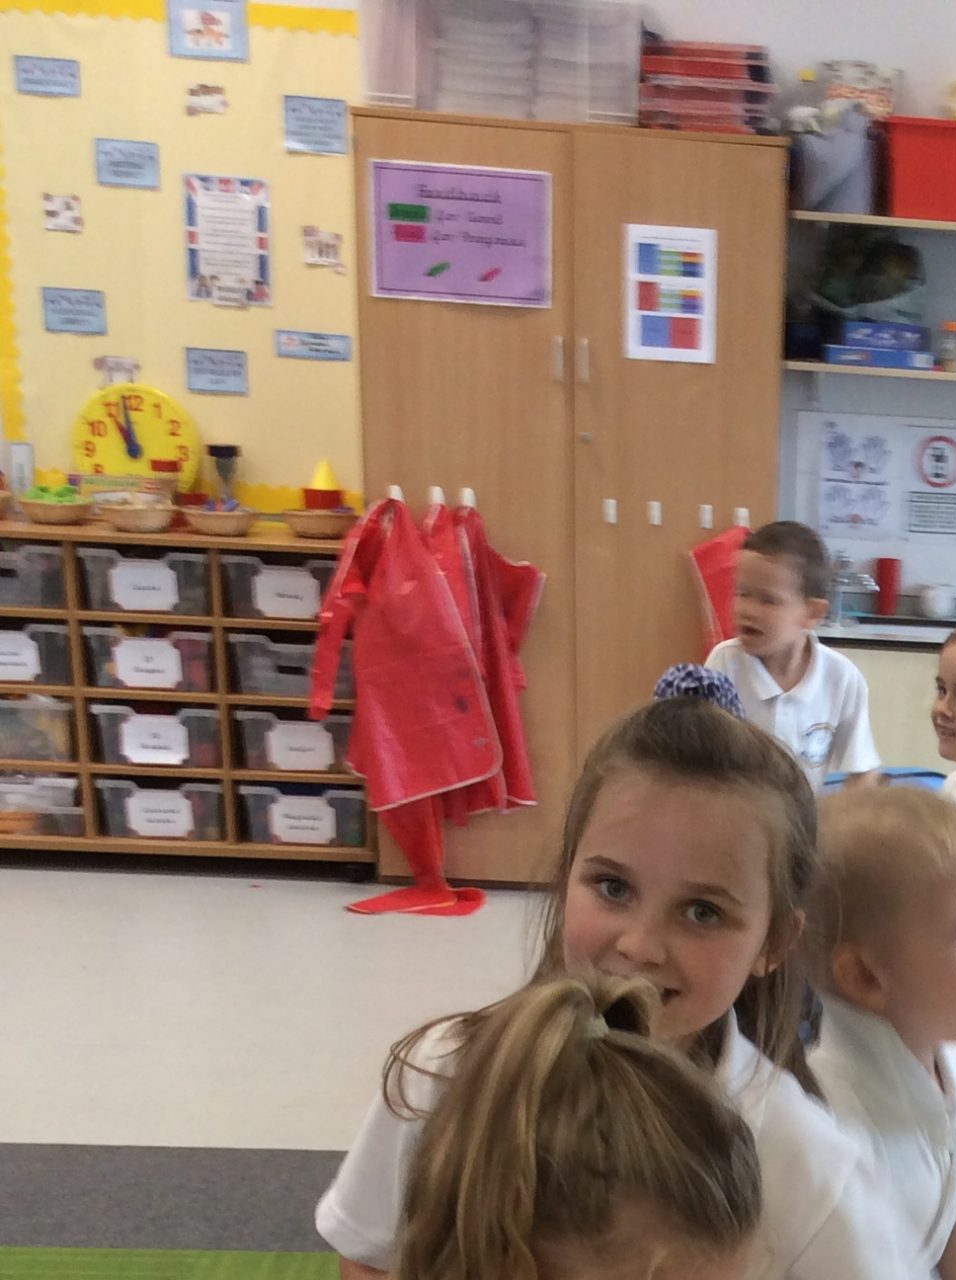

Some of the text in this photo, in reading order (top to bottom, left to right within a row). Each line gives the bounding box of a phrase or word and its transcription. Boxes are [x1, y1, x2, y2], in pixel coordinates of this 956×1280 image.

[124, 394, 144, 411] 12
[87, 420, 107, 437] 10
[168, 419, 181, 437] 2
[84, 441, 96, 457] 9
[177, 445, 190, 462] 3
